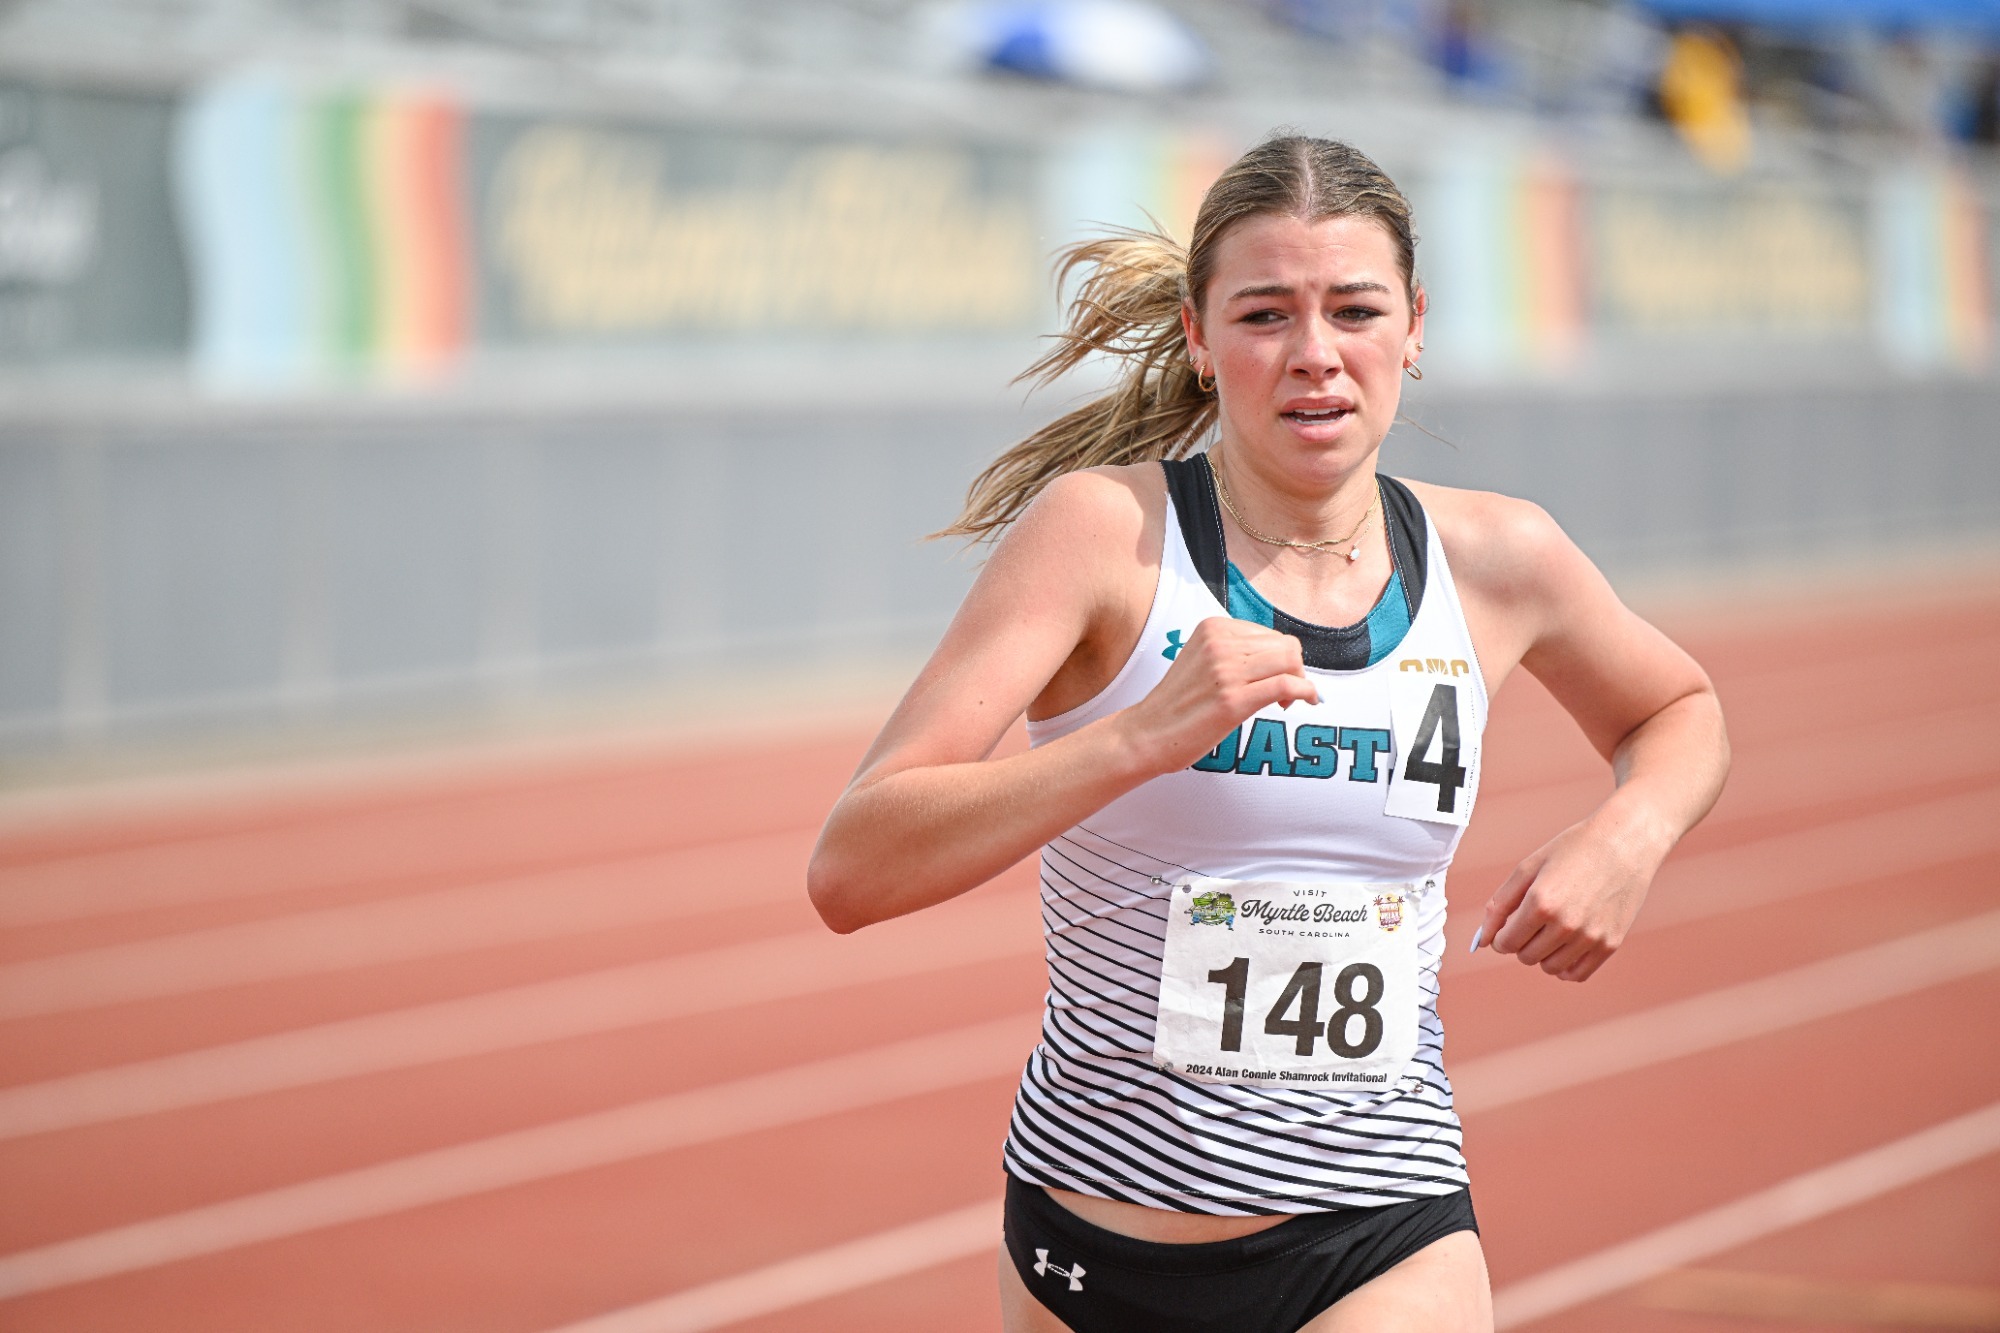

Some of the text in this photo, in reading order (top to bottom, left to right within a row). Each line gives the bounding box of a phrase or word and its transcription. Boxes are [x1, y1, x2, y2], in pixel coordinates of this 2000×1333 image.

[1404, 683, 1466, 813] 4
[1293, 889, 1327, 898] VISIT
[1240, 899, 1310, 925] Myrtle
[1313, 902, 1368, 923] Beach
[1258, 928, 1294, 937] SOUTH
[1207, 956, 1385, 1059] 148
[1185, 1063, 1387, 1083] 2024 Alan Connie Shamrock Invitational
